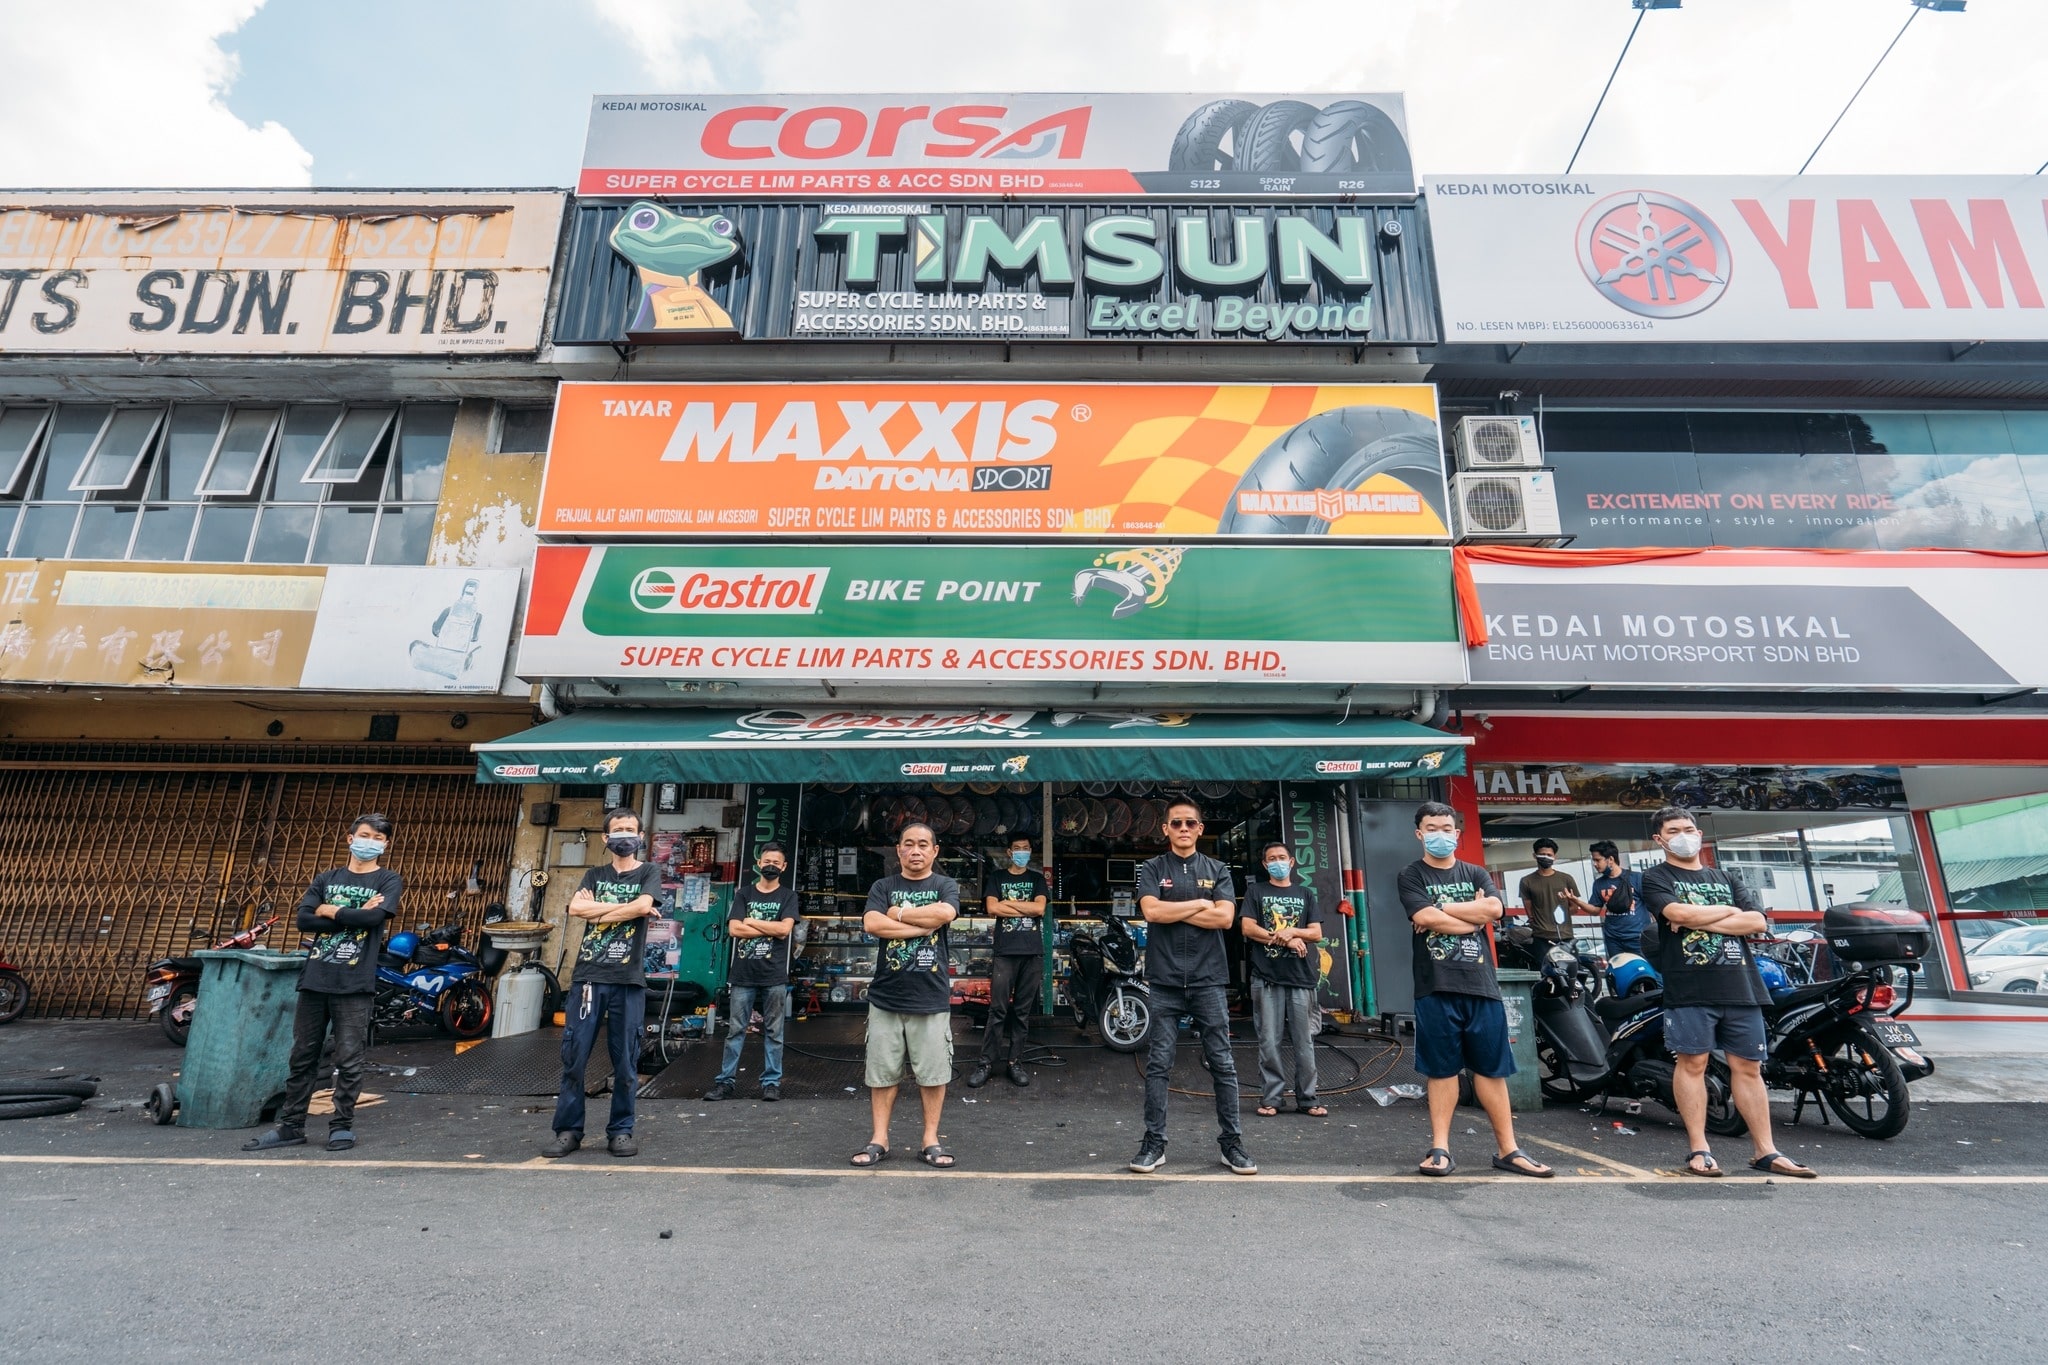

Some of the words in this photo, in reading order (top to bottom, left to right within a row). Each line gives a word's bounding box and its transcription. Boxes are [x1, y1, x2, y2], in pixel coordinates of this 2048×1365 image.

[602, 102, 637, 111] KEDAI
[640, 102, 708, 112] MOTOSIKAL
[606, 174, 677, 188] SUPER
[683, 174, 754, 188] CYCLE
[759, 174, 795, 188] LIM
[801, 174, 871, 188] PARTS
[877, 175, 892, 188] &
[898, 174, 942, 188] ACC
[949, 174, 993, 188] SDN
[1000, 174, 1044, 188] BHD
[1190, 179, 1220, 189] S123
[1259, 177, 1296, 185] SPORT
[1263, 184, 1291, 192] RAIN
[1338, 180, 1365, 189] R26
[1436, 183, 1488, 196] KEDAI
[1492, 183, 1595, 196] MOTOSIKAL
[826, 205, 860, 214] KEDAI
[863, 205, 929, 214] MOTOSIKAL
[813, 215, 1373, 286] TIMSUN
[1731, 198, 2048, 309] YAM
[129, 269, 299, 335] SDN.
[332, 269, 508, 335] BHD.
[799, 291, 860, 310] SUPER
[865, 292, 923, 310] CYCLE
[929, 293, 963, 310] LIM
[968, 294, 1028, 310] PARTS
[1032, 295, 1047, 310] &
[795, 314, 926, 331] ACCESSORIES
[930, 314, 977, 331] SDN.
[981, 315, 1028, 332] BHD.
[1089, 296, 1199, 331] Excel
[1212, 296, 1372, 340] Beyond
[1456, 321, 1477, 331] NO.
[1480, 321, 1513, 331] LESEN
[1516, 321, 1549, 331] MBPJ:
[1552, 320, 1654, 331] EL2560000633614
[602, 400, 673, 417] TAYAR
[660, 399, 1060, 462] MAXXIS
[814, 466, 970, 492] DAYTONA
[972, 466, 1052, 491] SPORT
[1240, 493, 1317, 512] MAXXIS
[1344, 494, 1420, 513] RACING
[1586, 494, 1721, 509] EXCITEMENT
[1730, 494, 1763, 510] ON
[1770, 494, 1838, 510] EVERY
[1849, 494, 1899, 511] RIDE
[555, 507, 593, 523] PENJUAL
[595, 508, 616, 523] ALAT
[618, 508, 644, 523] GANTI
[646, 508, 693, 524] MOTOSIKAL
[696, 508, 716, 524] DAN
[717, 508, 759, 524] AKSESORI
[767, 507, 810, 528] SUPER
[816, 507, 857, 528] CYCLE
[861, 508, 884, 528] LIM
[889, 508, 931, 528] PARTS
[936, 508, 948, 528] &
[952, 508, 1041, 529] ACCESSORIES
[1046, 508, 1078, 529] SDN.
[1083, 508, 1115, 529] BHD.
[1590, 514, 1703, 528] performance
[1734, 514, 1776, 528] style
[1806, 514, 1900, 527] innovation
[680, 573, 816, 609] Castrol
[845, 580, 925, 601] BIKE
[935, 580, 1041, 602] POINT
[1486, 614, 1602, 638] KEDAI
[1622, 615, 1851, 639] MOTOSIKAL
[620, 646, 704, 667] SUPER
[711, 648, 791, 668] CYCLE
[796, 648, 845, 668] LIM
[852, 648, 933, 669] PARTS
[941, 649, 960, 669] &
[967, 649, 1144, 670] ACCESSORIES
[1152, 650, 1214, 671] SDN.
[1223, 650, 1287, 671] BHD.
[1488, 644, 1533, 661] ENG
[1540, 645, 1596, 662] HUAT
[1603, 645, 1756, 662] MOTORSPORT
[1763, 646, 1809, 663] SDN
[1816, 646, 1860, 663] BHD
[807, 712, 1014, 729] Castrol
[708, 730, 853, 740] BIKE
[863, 726, 1042, 738] POINT
[505, 766, 538, 776] Castrol
[542, 766, 561, 774] BIKE
[562, 766, 587, 774] POINT
[912, 764, 946, 775] Castrol
[950, 765, 969, 773] BIKE
[971, 765, 996, 773] POINT
[1326, 761, 1360, 772] Castrol
[1366, 761, 1386, 769] BIKE
[1387, 761, 1412, 769] POINT
[1315, 801, 1328, 839] Beyond
[1317, 839, 1330, 870] Excel
[891, 890, 938, 901] TIMSUN
[1262, 896, 1304, 905] TIMSUN
